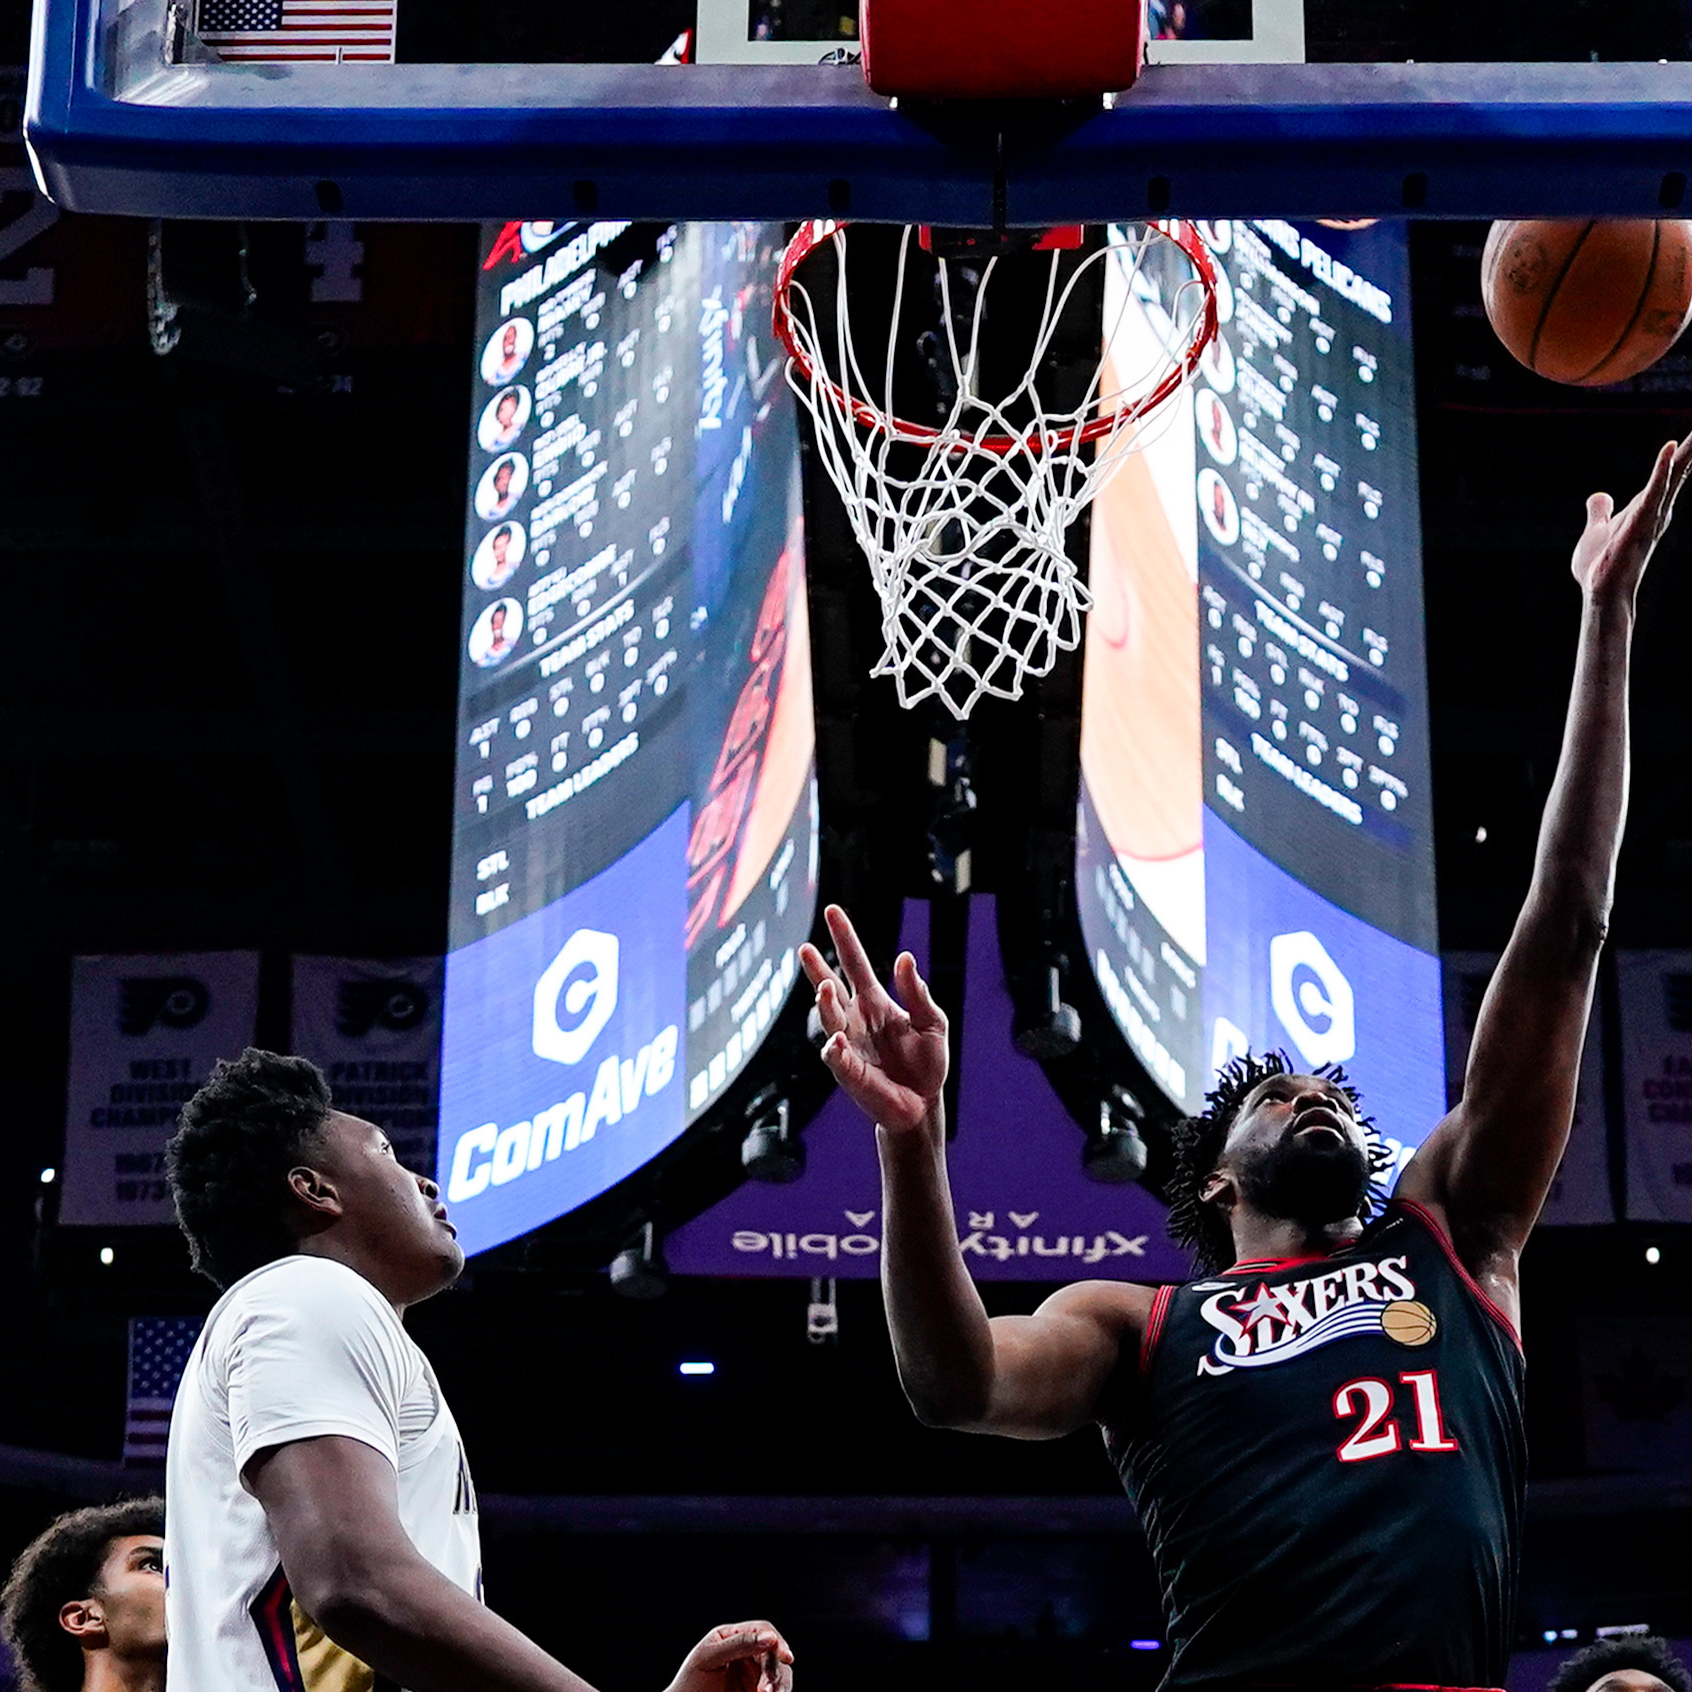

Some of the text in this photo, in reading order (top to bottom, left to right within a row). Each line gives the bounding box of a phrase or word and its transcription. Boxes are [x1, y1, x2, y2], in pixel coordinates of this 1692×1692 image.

[448, 1024, 679, 1203] ComAve
[731, 1229, 881, 1262] obile
[1332, 1367, 1459, 1463] 21
